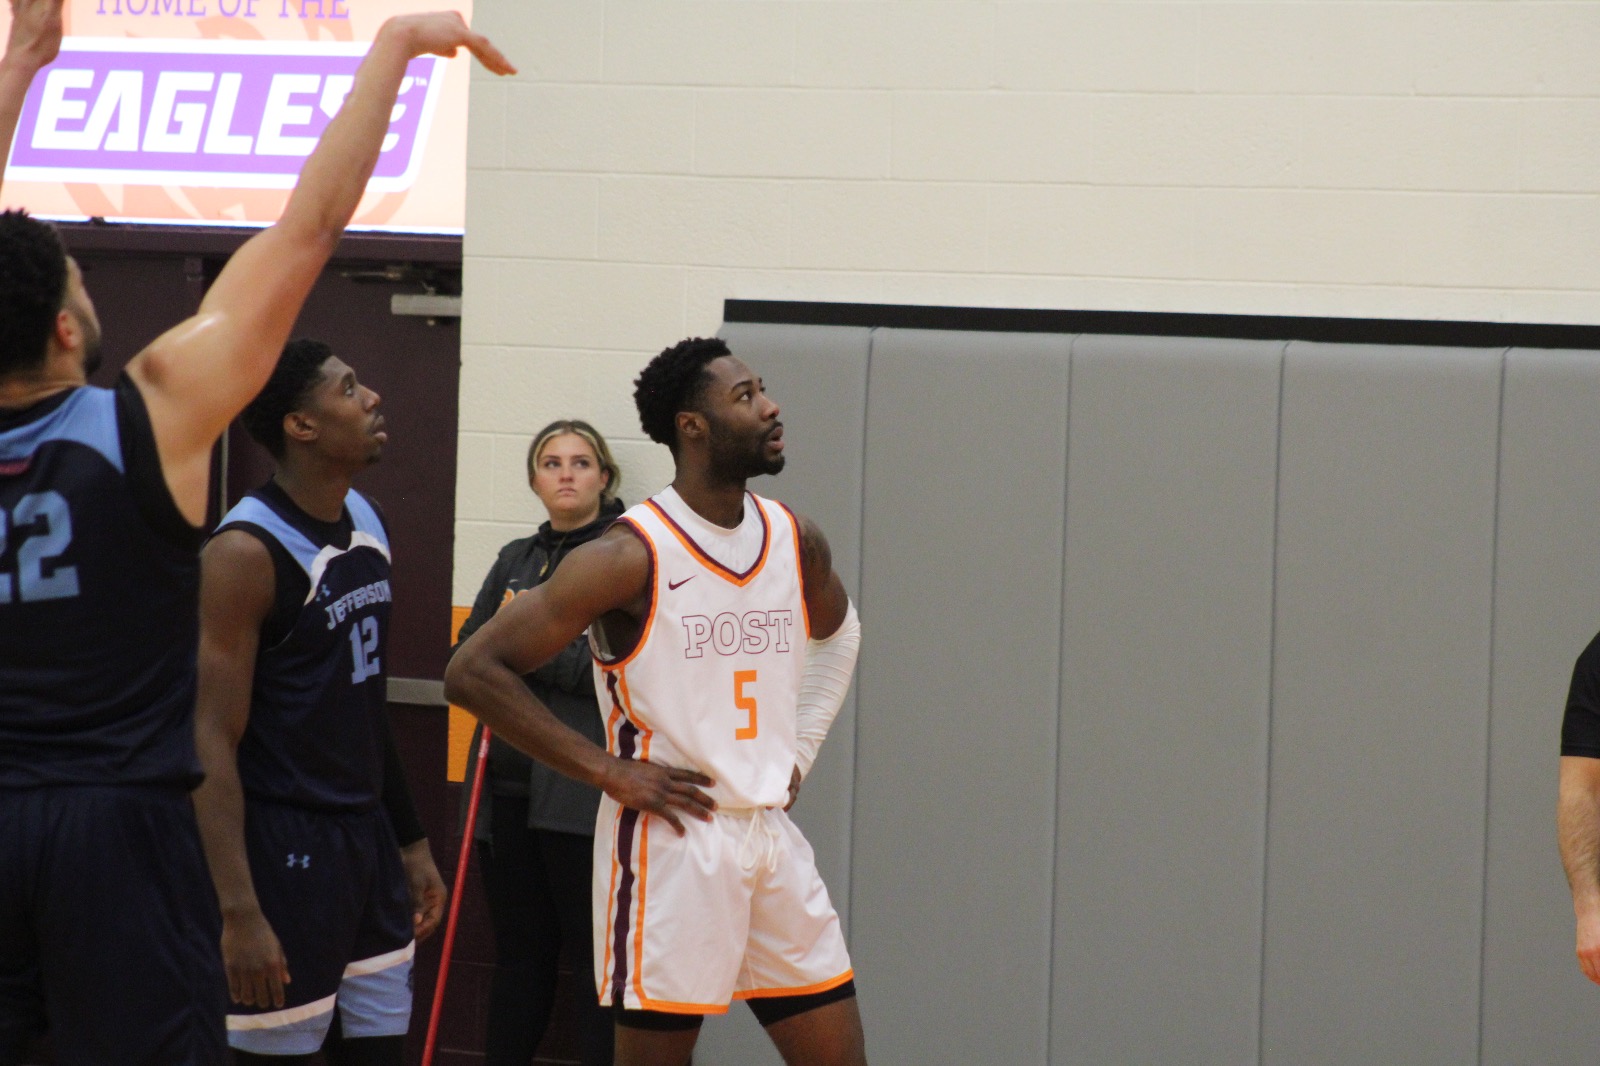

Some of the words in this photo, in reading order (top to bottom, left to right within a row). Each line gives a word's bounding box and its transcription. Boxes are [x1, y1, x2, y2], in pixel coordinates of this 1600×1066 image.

[0, 490, 80, 604] 2
[324, 580, 392, 630] JEFFERSON
[682, 609, 792, 659] POST
[349, 615, 380, 685] 12
[733, 669, 758, 740] 5
